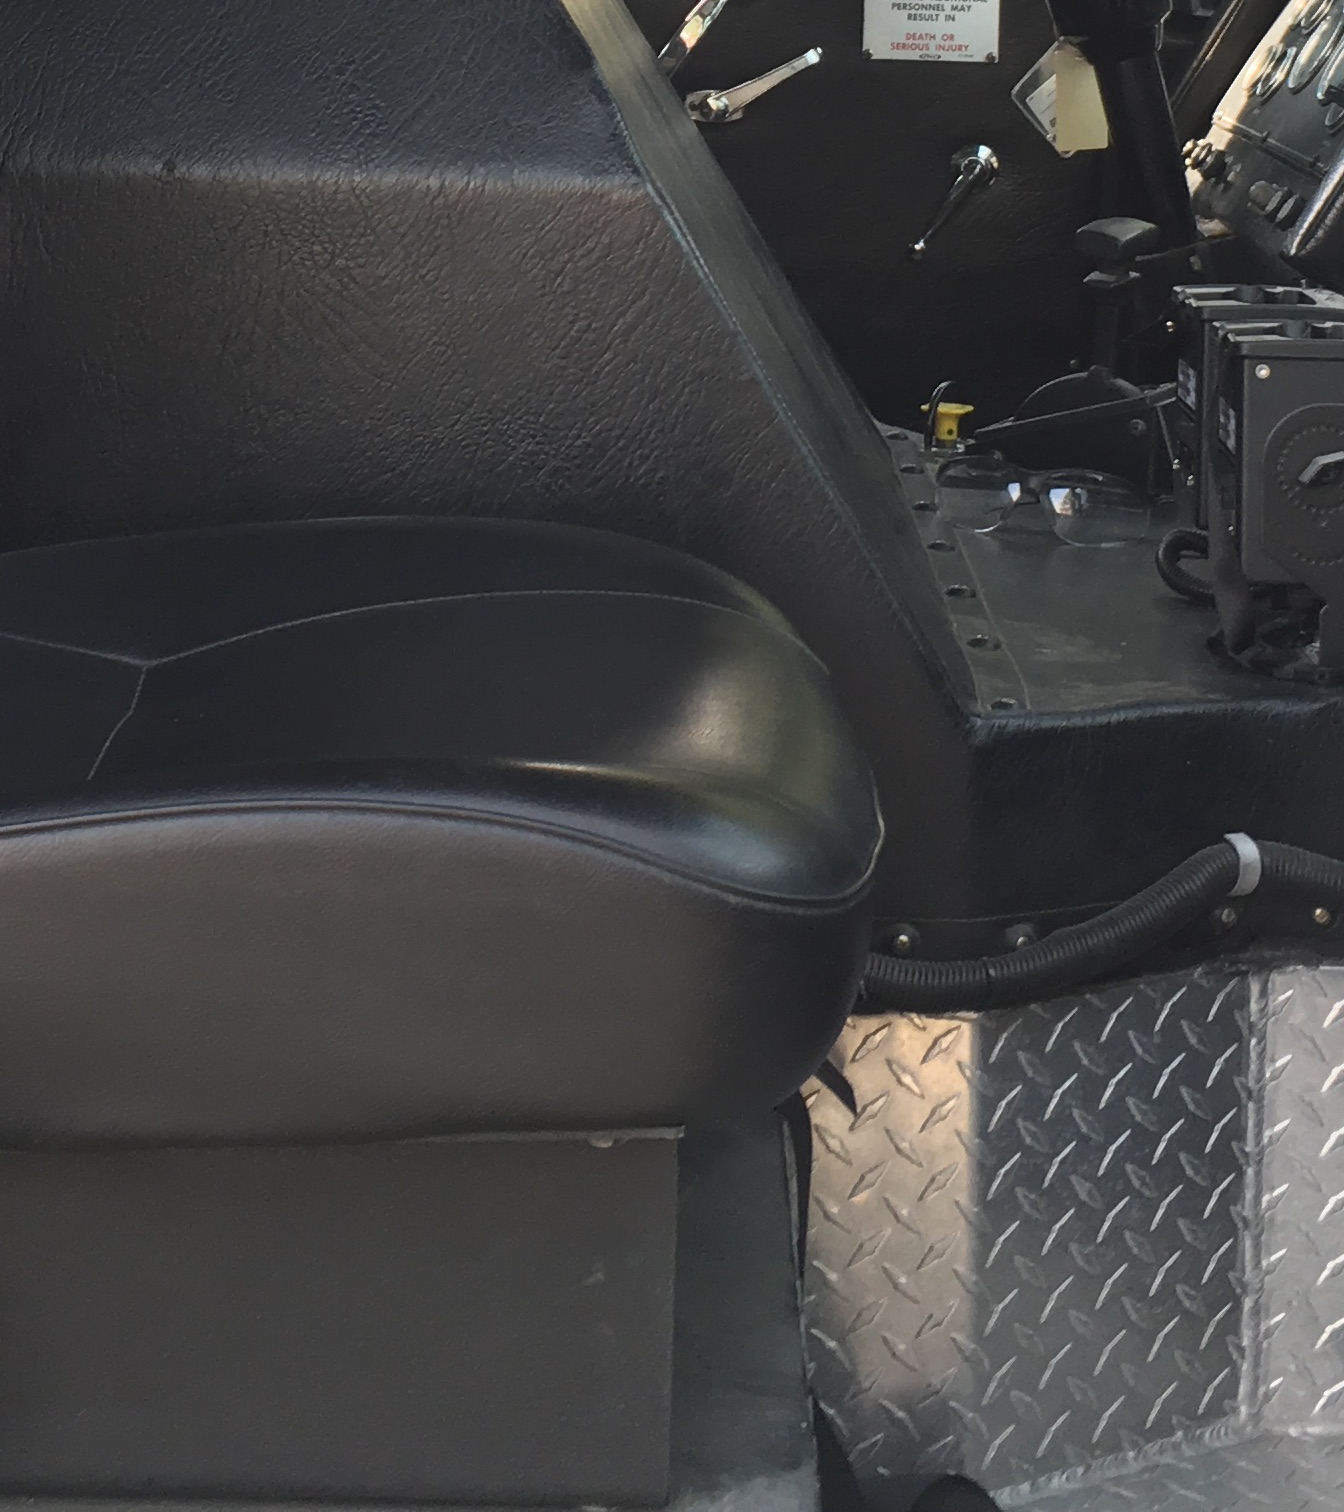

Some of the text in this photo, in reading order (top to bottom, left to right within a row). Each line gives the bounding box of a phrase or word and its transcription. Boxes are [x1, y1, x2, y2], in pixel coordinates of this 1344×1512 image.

[891, 2, 972, 12] PERSONNEL MAY
[907, 13, 956, 22] RESULT IN
[905, 32, 955, 42] DEATH OR
[890, 42, 970, 52] SERIOUS INJURY
